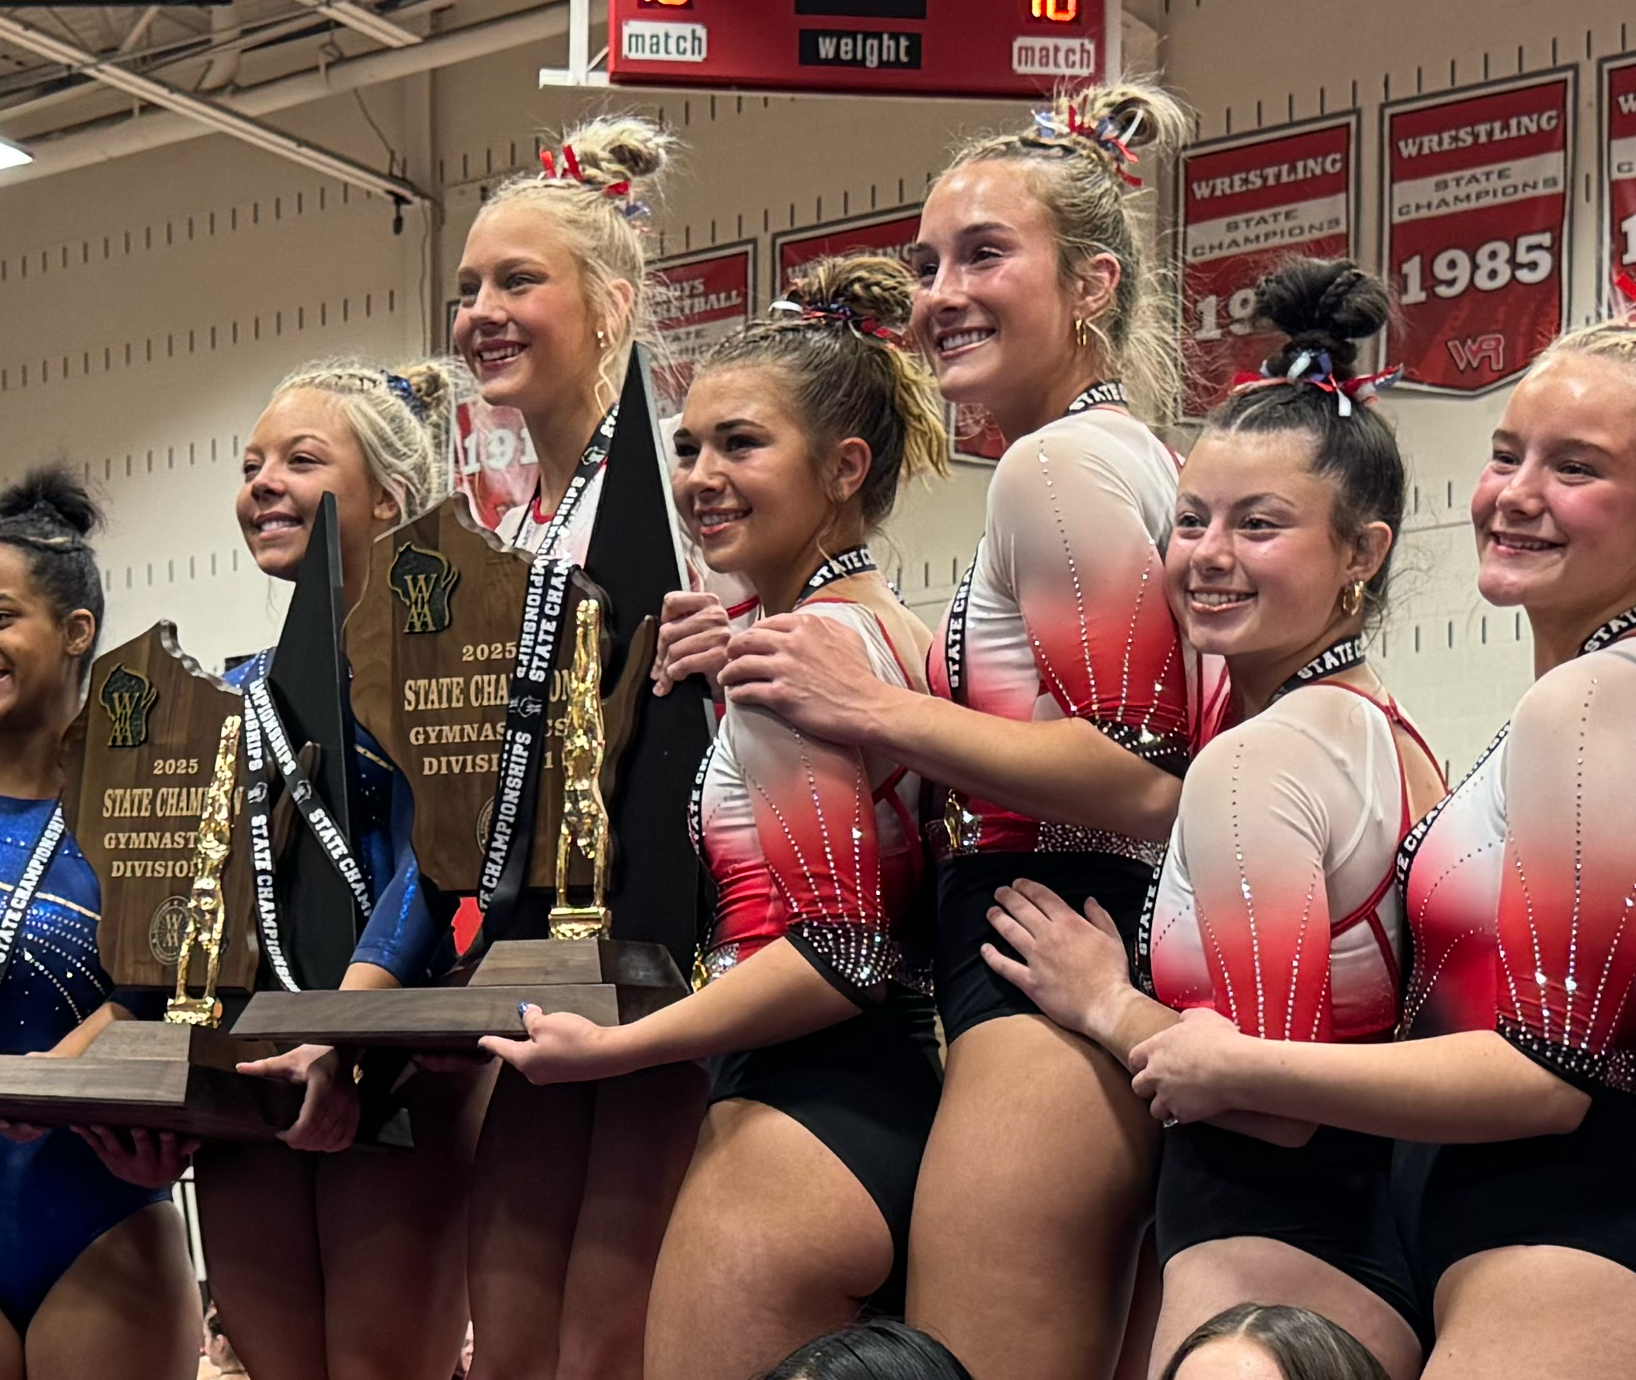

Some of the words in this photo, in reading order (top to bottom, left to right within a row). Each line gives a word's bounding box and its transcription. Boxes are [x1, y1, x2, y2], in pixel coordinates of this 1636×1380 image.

[628, 27, 704, 57] match
[818, 33, 910, 68] weight
[1017, 42, 1092, 72] match
[1398, 110, 1559, 159] WRESTLING
[1191, 152, 1344, 201] WRESTLING
[1397, 176, 1559, 217] CHAMPIONS
[1433, 167, 1512, 193] STATE
[1191, 216, 1342, 258] CHAMPIONS
[1225, 207, 1299, 234] STATE
[1400, 231, 1554, 307] 1985
[1195, 287, 1261, 341] 19
[462, 642, 518, 662] 2025
[529, 623, 557, 683] STATE
[946, 619, 964, 689] STATE
[1297, 638, 1356, 681] STATE
[404, 676, 465, 712] STATE
[152, 758, 199, 775] 2025
[423, 753, 500, 776] DIVISI
[102, 788, 153, 818] STATE
[481, 730, 533, 885] CHAMPIONSHIPS
[103, 831, 200, 850] GYMNAST
[250, 814, 273, 871] STATE
[308, 807, 342, 861] STATE
[1138, 884, 1157, 956] STATE
